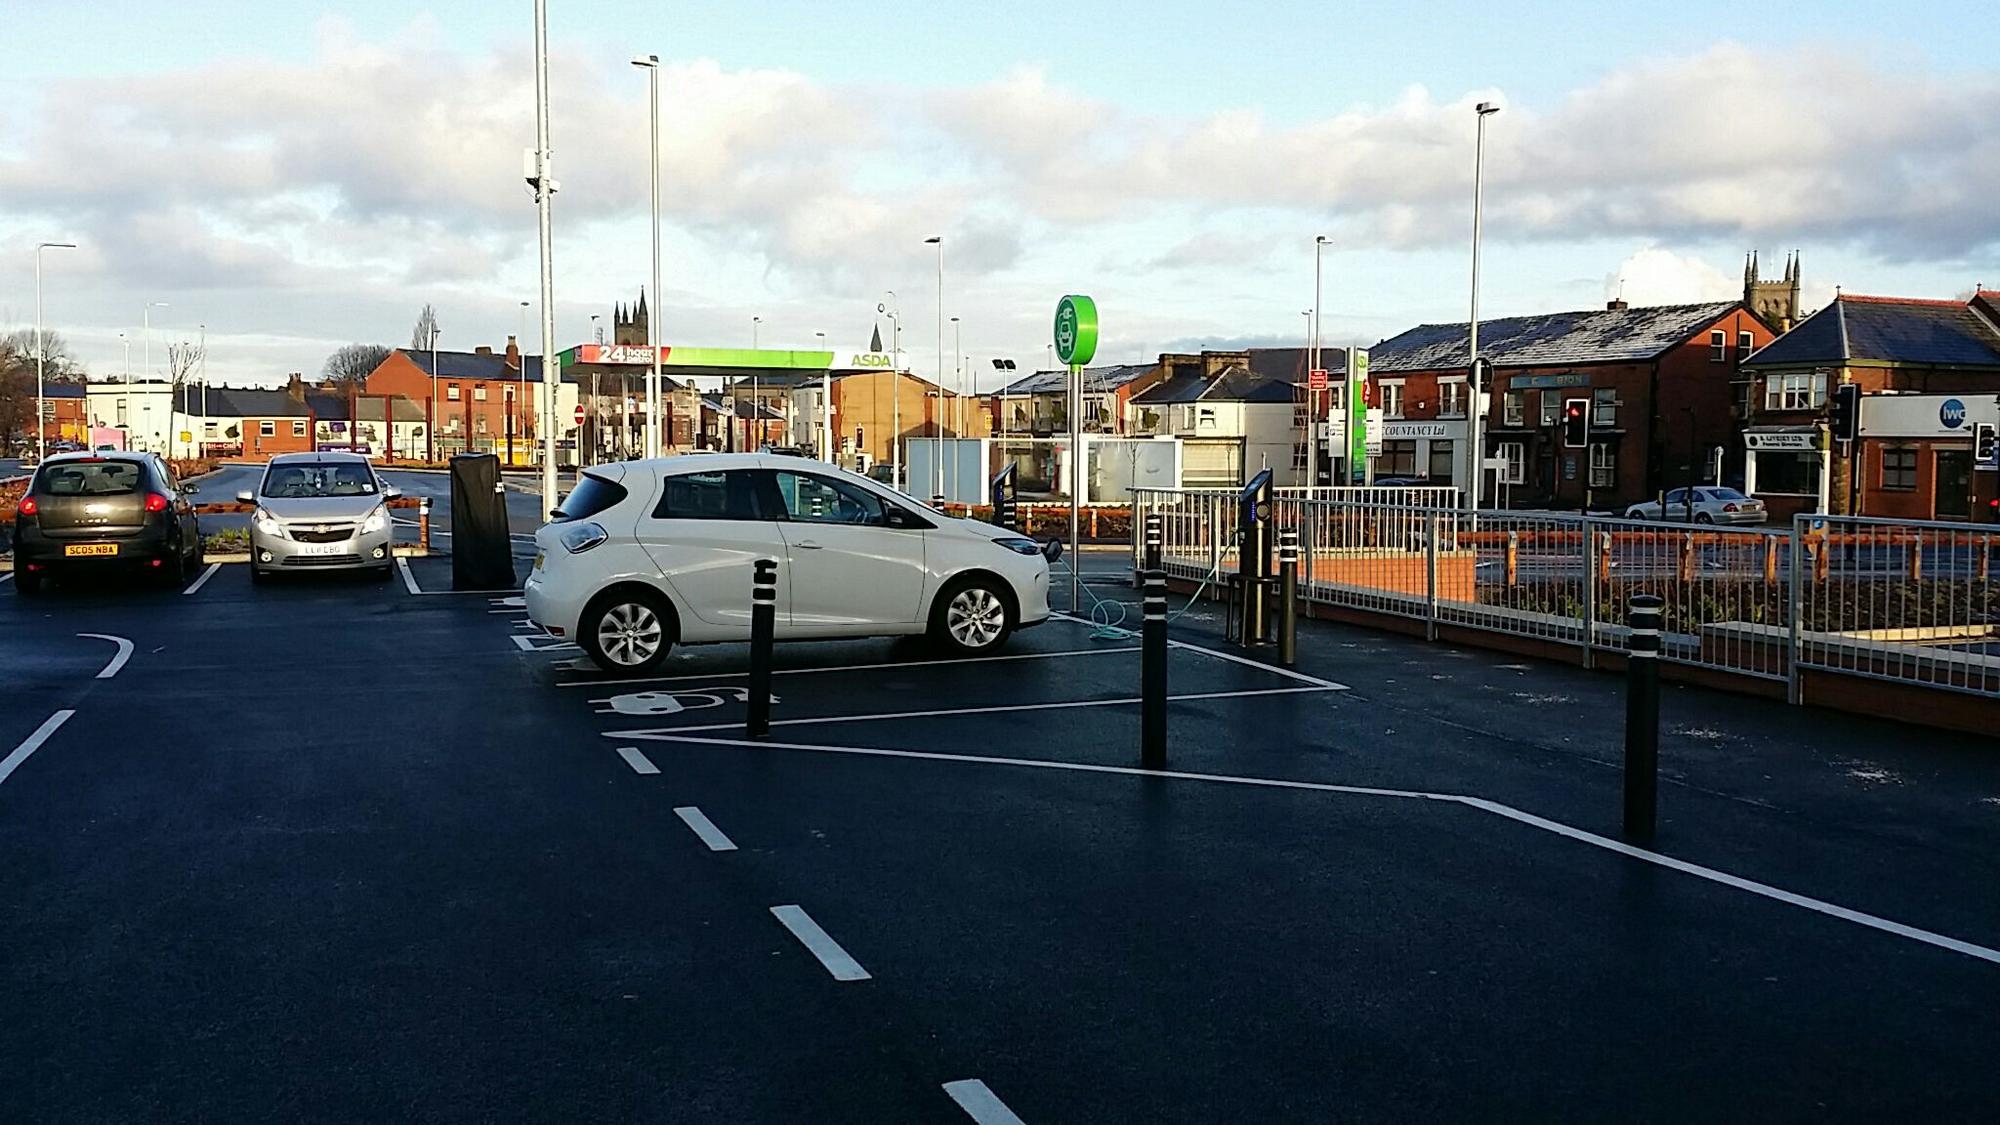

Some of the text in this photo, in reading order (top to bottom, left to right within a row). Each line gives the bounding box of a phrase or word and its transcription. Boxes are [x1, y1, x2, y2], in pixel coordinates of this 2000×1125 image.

[599, 346, 626, 362] 24
[627, 346, 654, 357] hour
[851, 354, 891, 368] ASDA
[1433, 425, 1445, 436] Ltd
[69, 546, 114, 555] SC05 NBA
